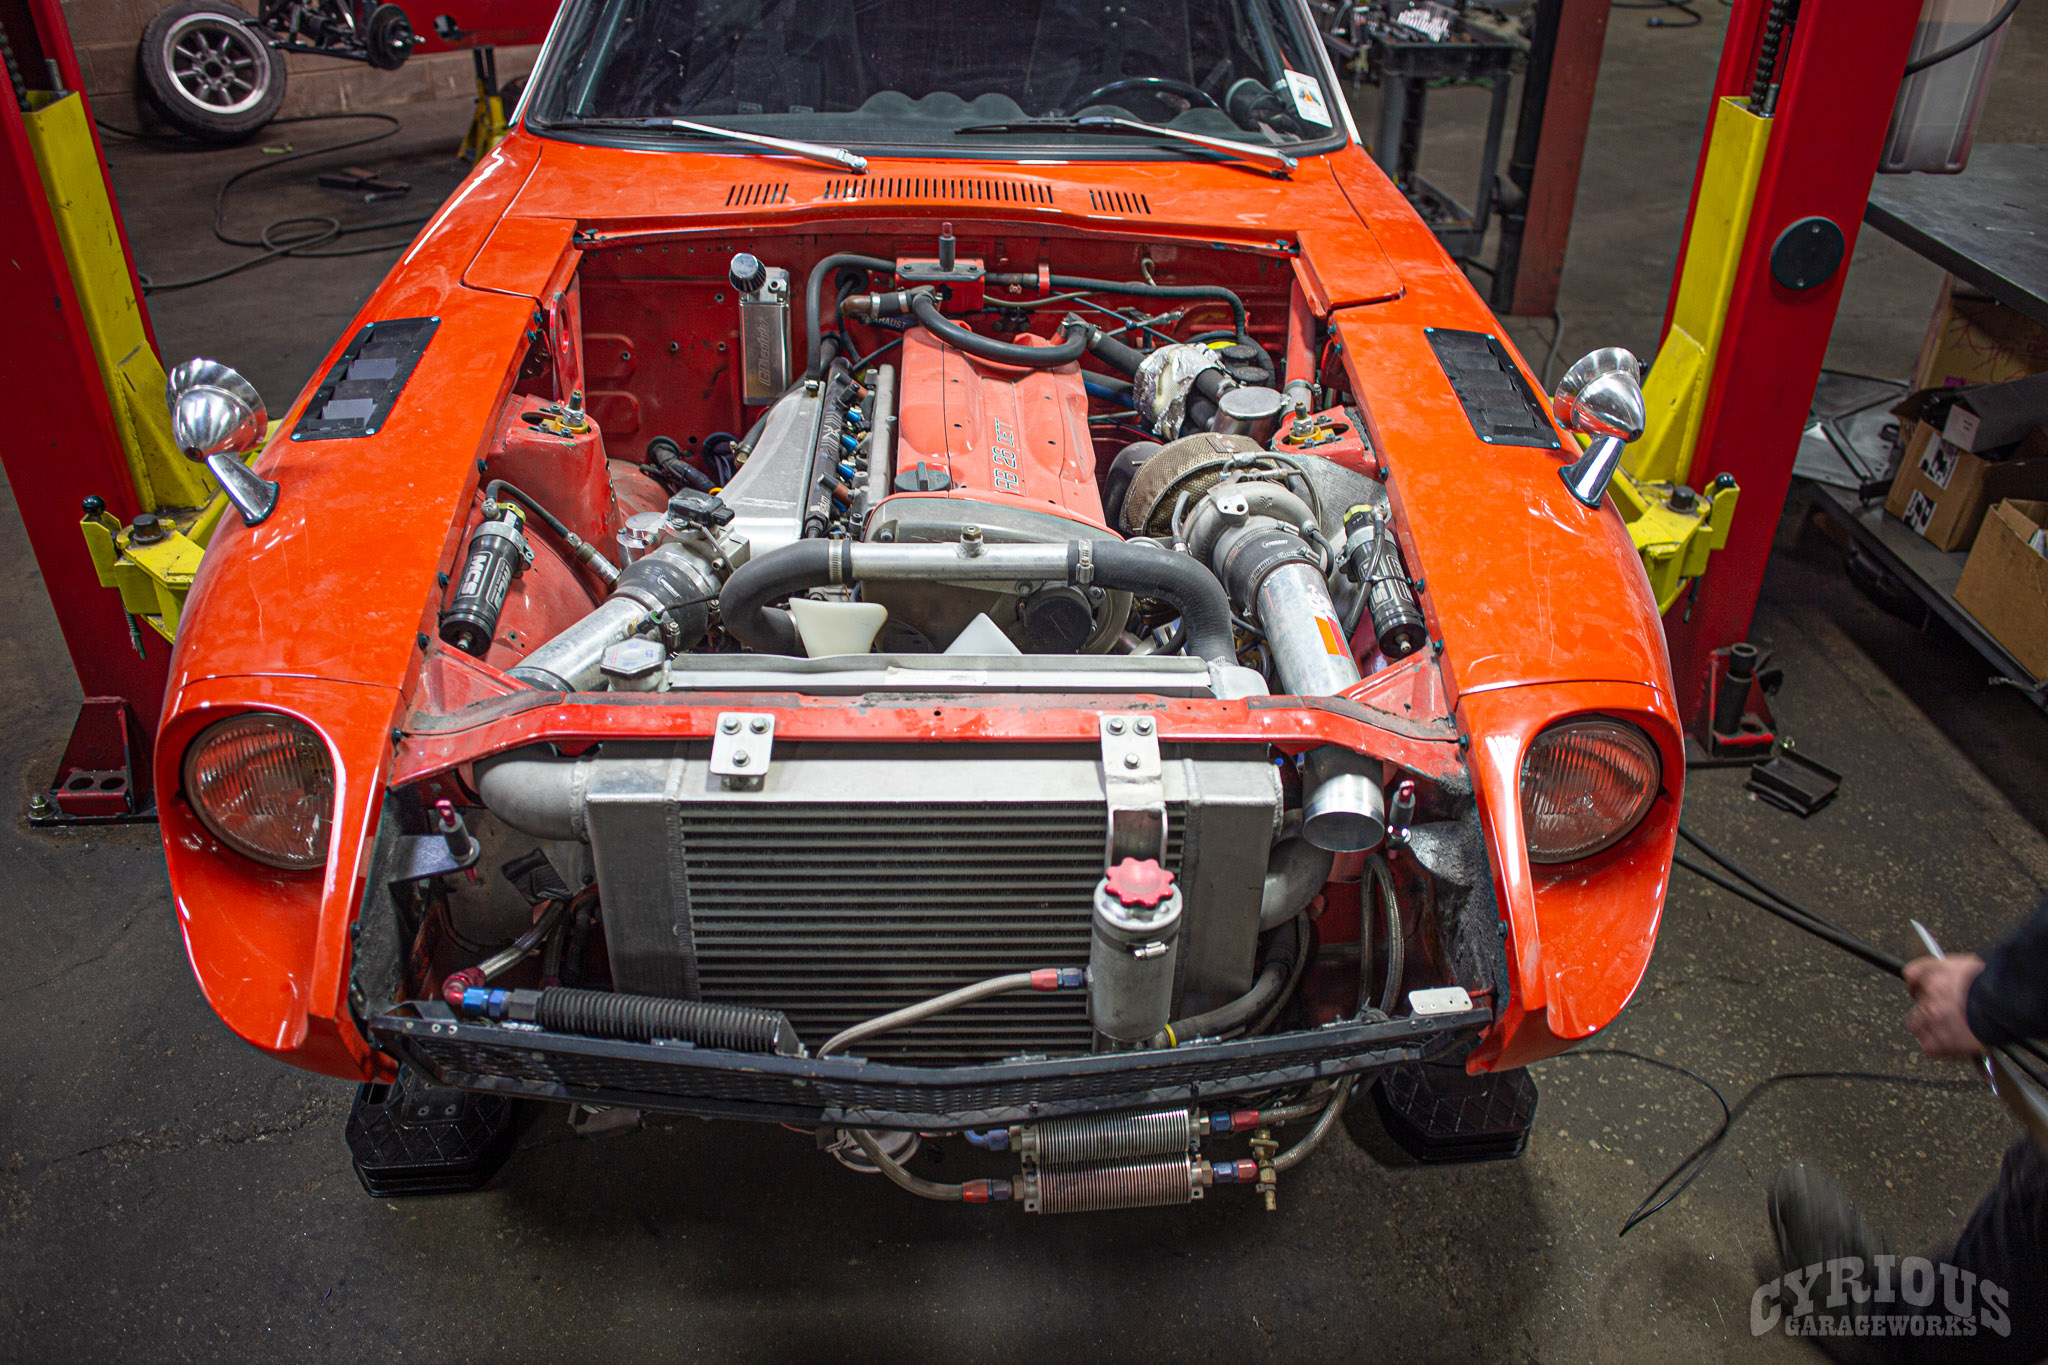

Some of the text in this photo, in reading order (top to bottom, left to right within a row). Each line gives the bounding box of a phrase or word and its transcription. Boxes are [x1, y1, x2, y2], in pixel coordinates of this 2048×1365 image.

[992, 446, 1017, 469] 26
[995, 468, 1020, 493] RB
[461, 555, 487, 595] MCS
